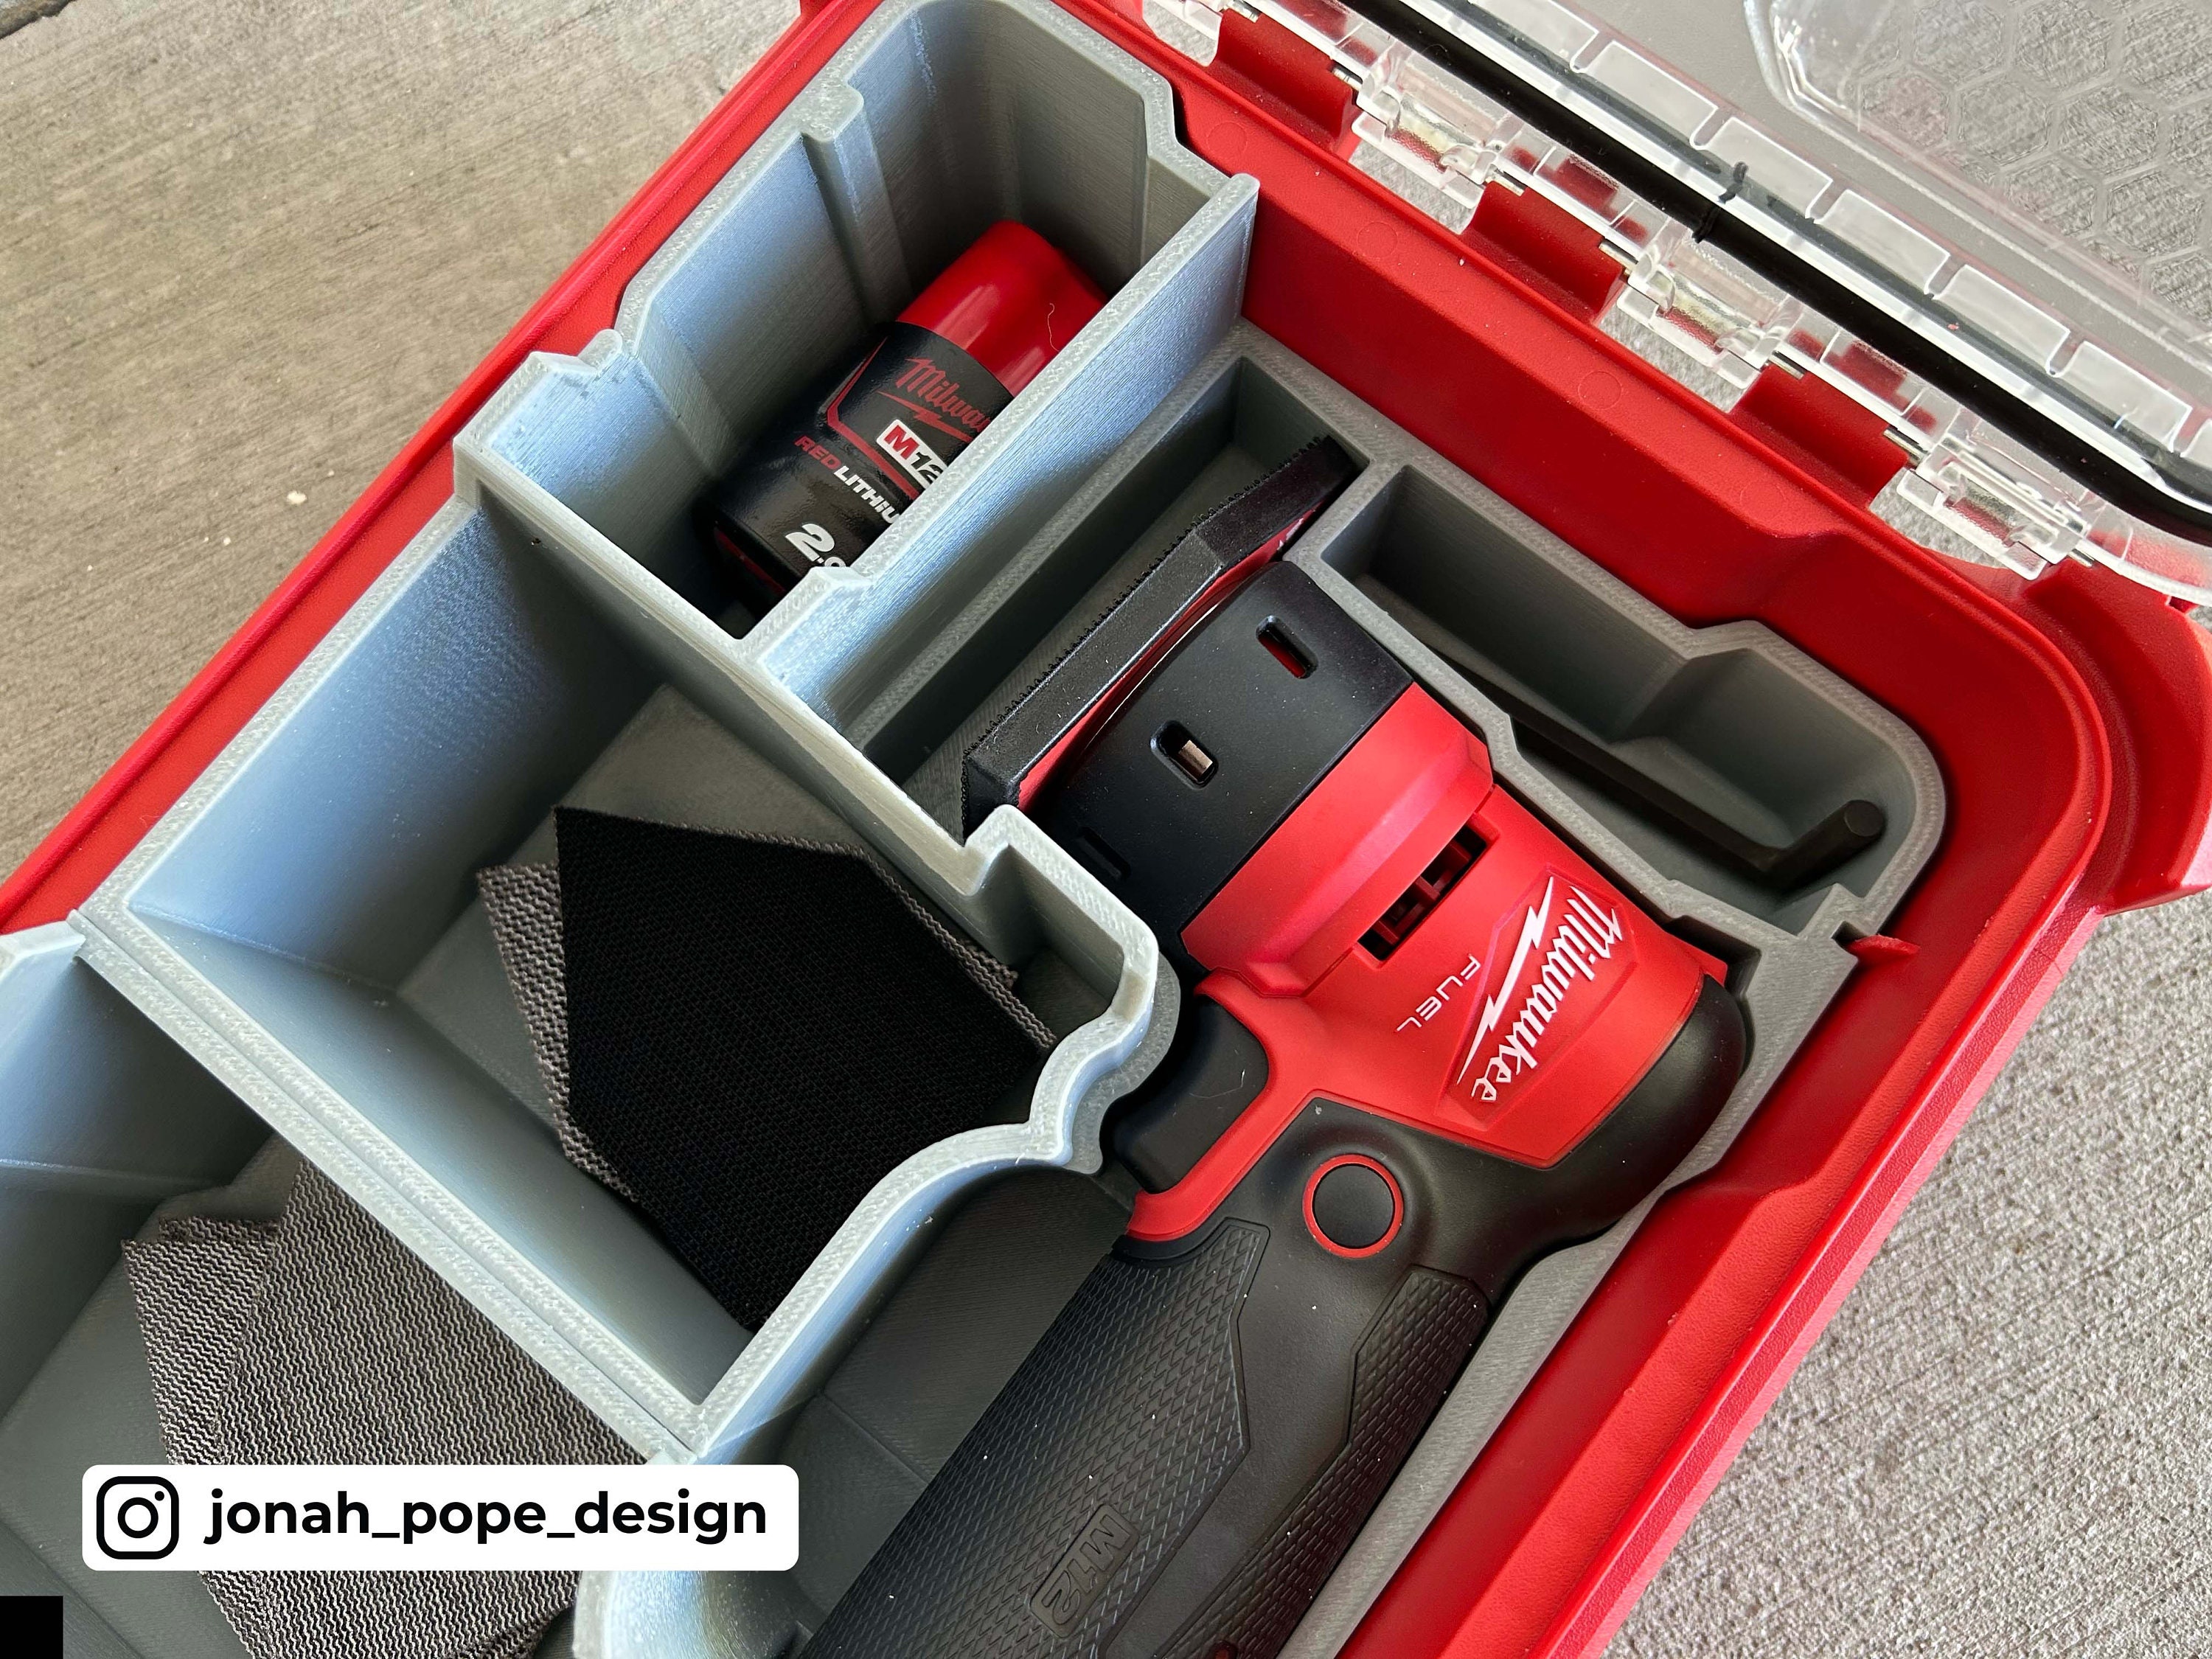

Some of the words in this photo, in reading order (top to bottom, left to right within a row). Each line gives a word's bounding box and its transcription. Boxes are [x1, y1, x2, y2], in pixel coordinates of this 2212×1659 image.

[883, 425, 945, 485] M12
[1397, 954, 1481, 1033] FUEL
[1471, 886, 1623, 1102] Milwaukee
[1040, 1514, 1132, 1626] M12
